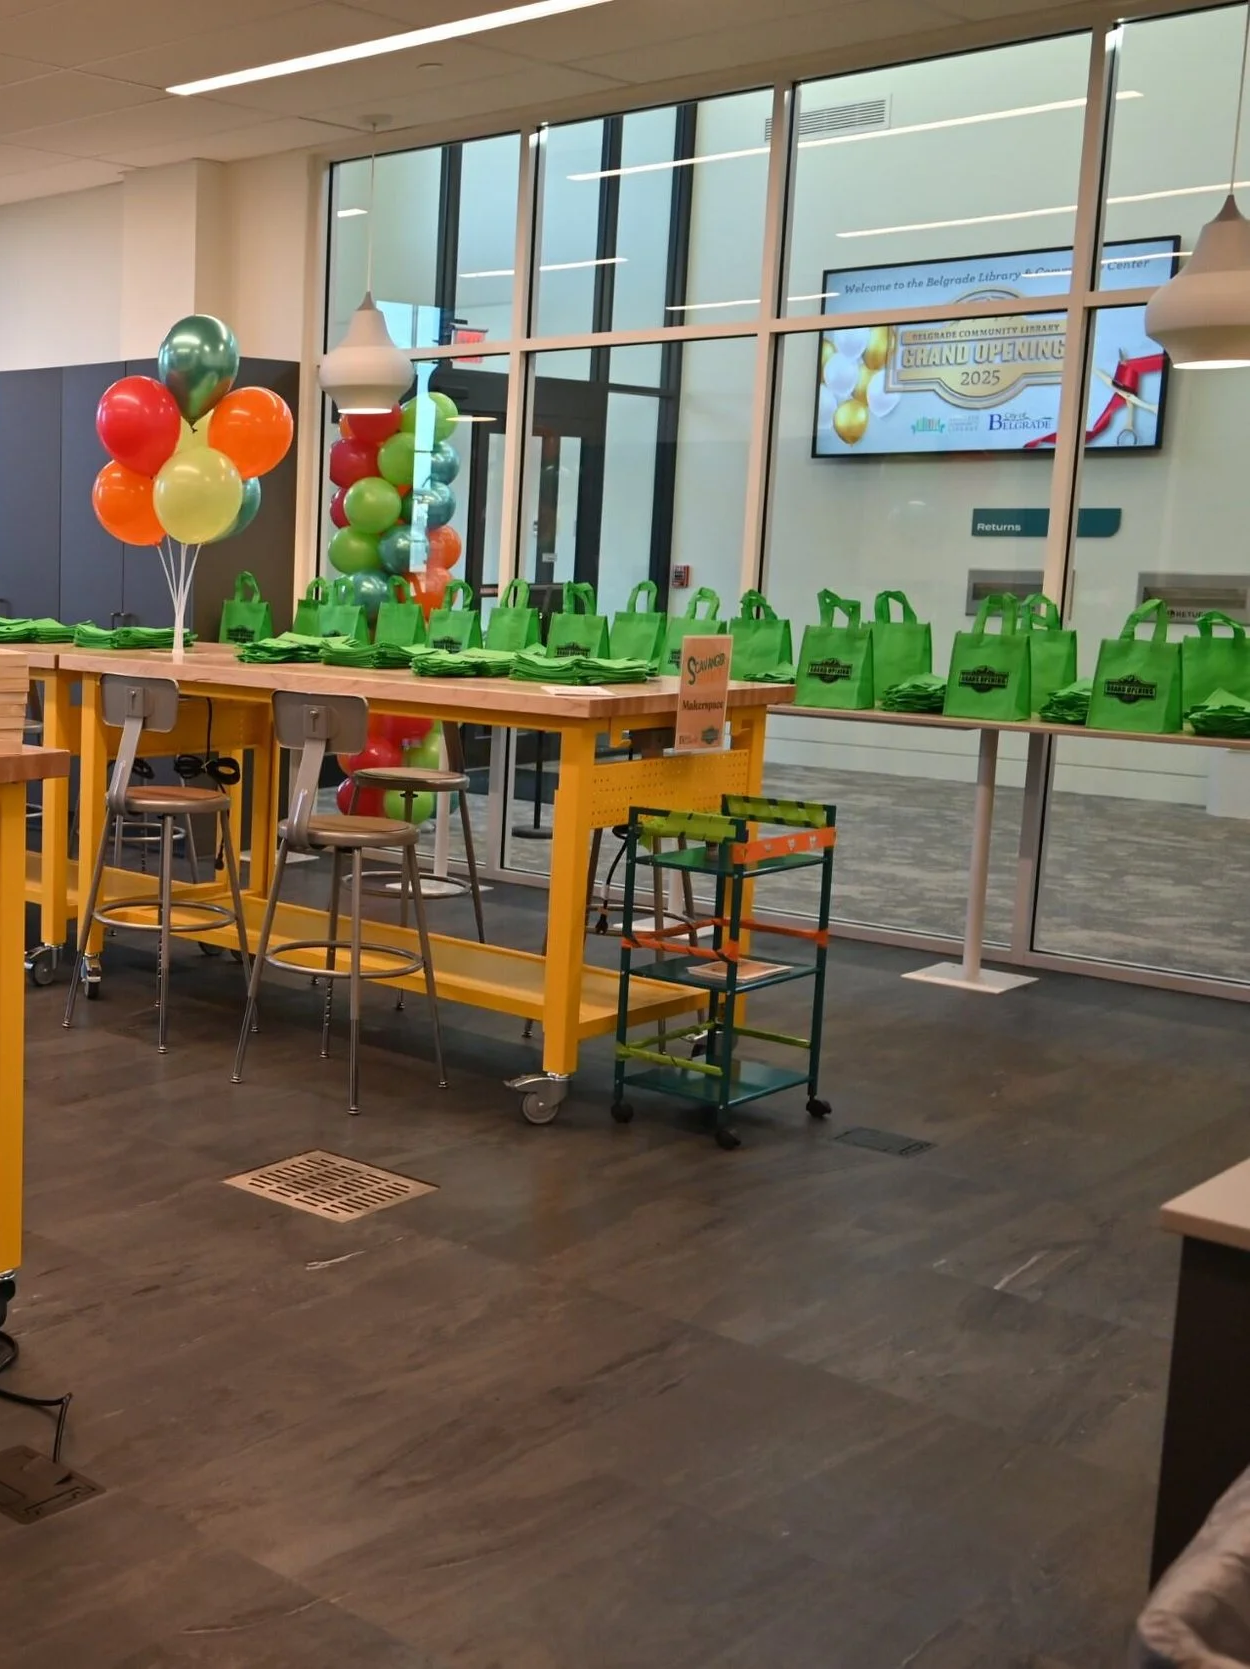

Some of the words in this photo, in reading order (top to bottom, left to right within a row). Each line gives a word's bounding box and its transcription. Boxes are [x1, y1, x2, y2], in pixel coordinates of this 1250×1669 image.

[845, 284, 892, 294] Welcome
[893, 281, 905, 290] to
[907, 278, 924, 289] the
[926, 273, 976, 288] Belgrade
[978, 269, 1021, 282] Library
[1107, 259, 1150, 271] Center
[912, 331, 957, 341] BELGRADE
[959, 326, 1018, 338] COMMUNITY
[1020, 323, 1060, 334] LIBRARY
[902, 343, 969, 368] GRAND
[973, 336, 1066, 364] OPENING
[960, 369, 1001, 386] 2025
[989, 413, 1052, 431] BELGRADE
[977, 523, 1021, 532] Returns
